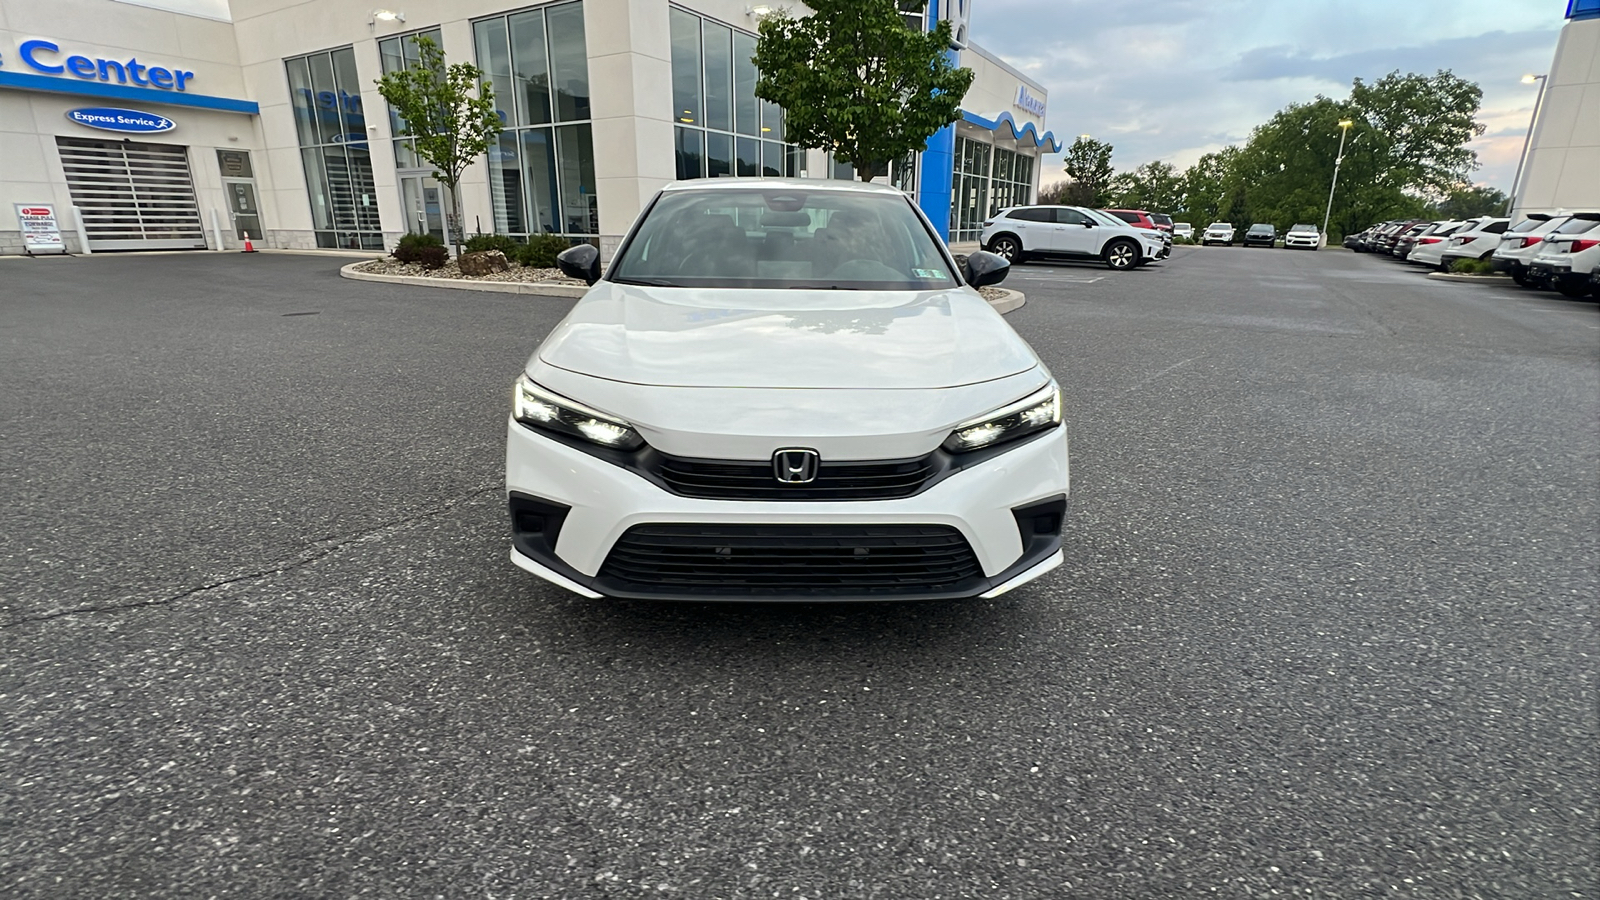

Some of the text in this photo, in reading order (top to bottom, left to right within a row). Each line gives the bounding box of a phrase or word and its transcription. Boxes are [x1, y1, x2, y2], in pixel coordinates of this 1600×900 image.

[19, 39, 195, 92] Center
[73, 111, 155, 127] Express Service
